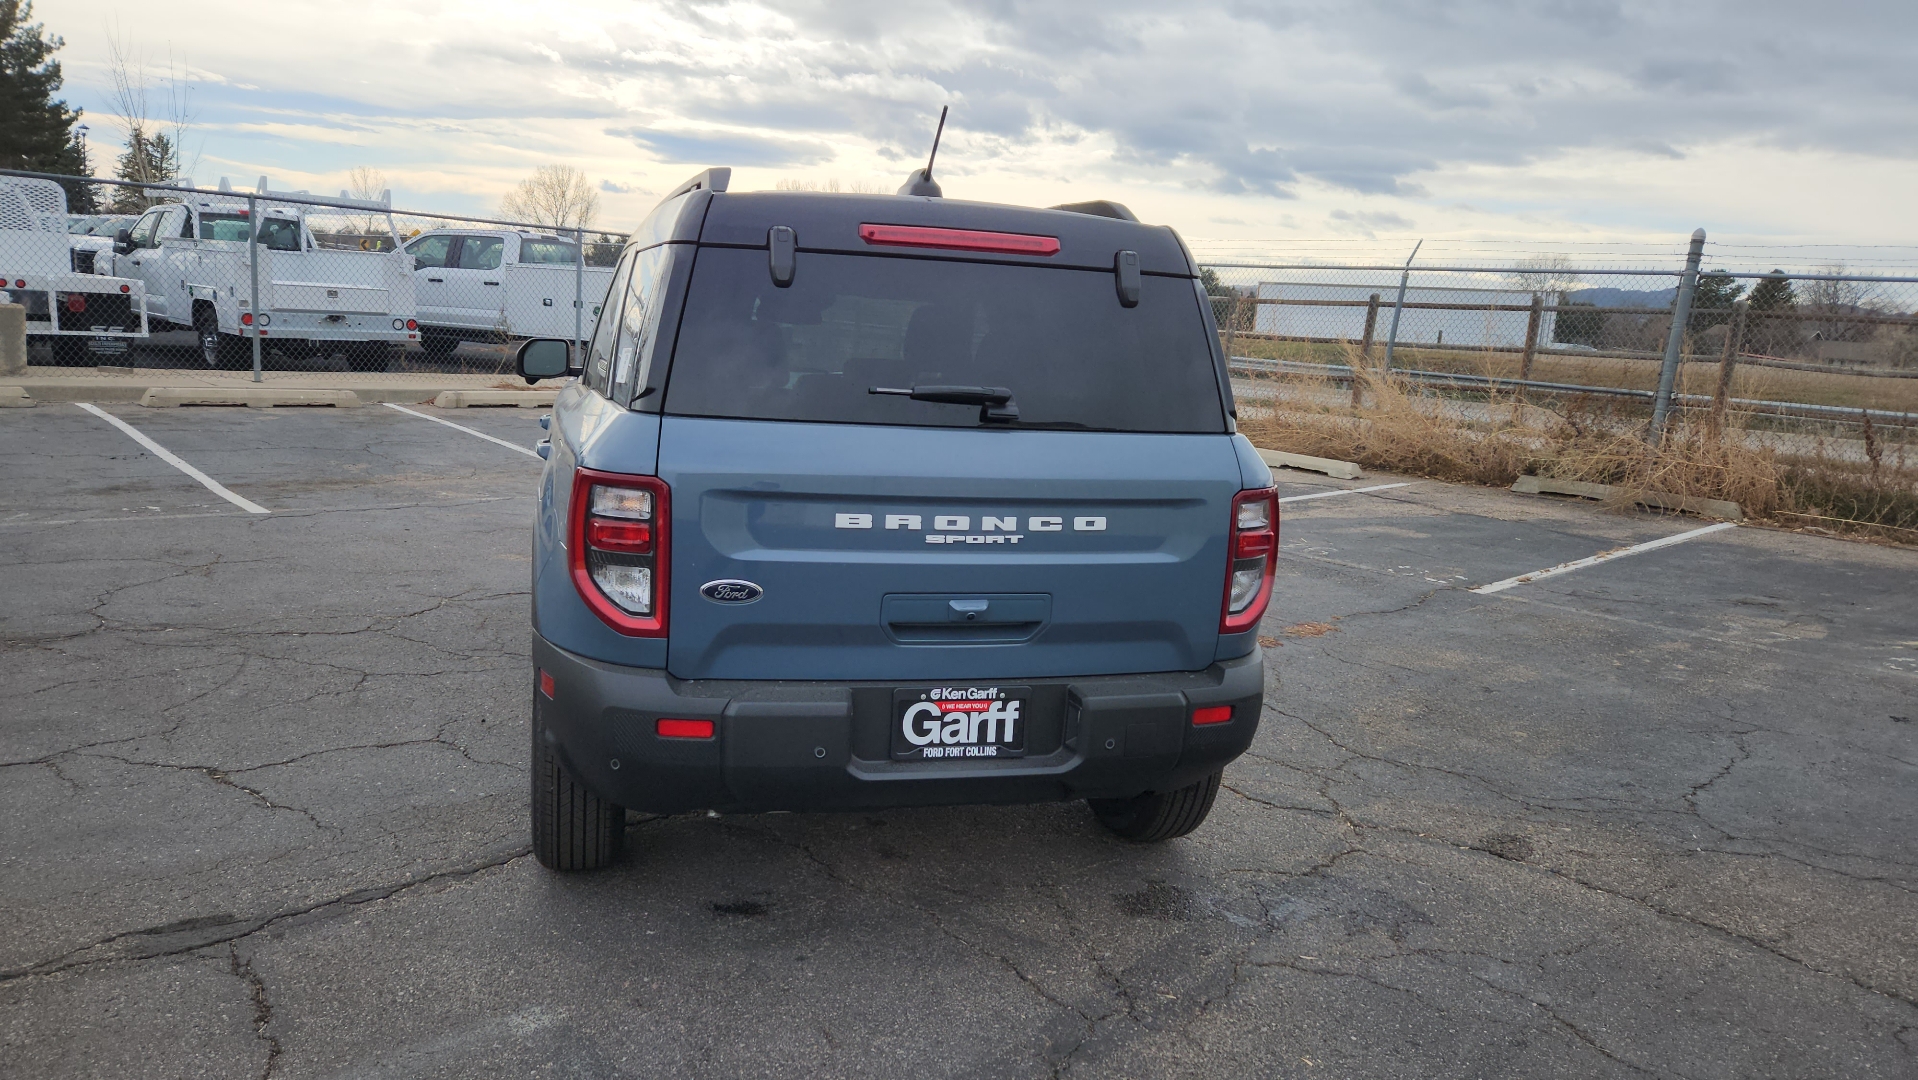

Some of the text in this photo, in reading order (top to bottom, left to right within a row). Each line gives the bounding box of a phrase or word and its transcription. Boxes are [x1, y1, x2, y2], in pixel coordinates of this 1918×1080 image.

[834, 513, 1107, 532] BRONCO
[925, 534, 1024, 544] SPORT
[714, 584, 749, 599] Ford
[941, 688, 998, 700] Ken Garff
[902, 700, 1020, 746] Garff
[923, 746, 997, 758] FORD FORT COLLINS
